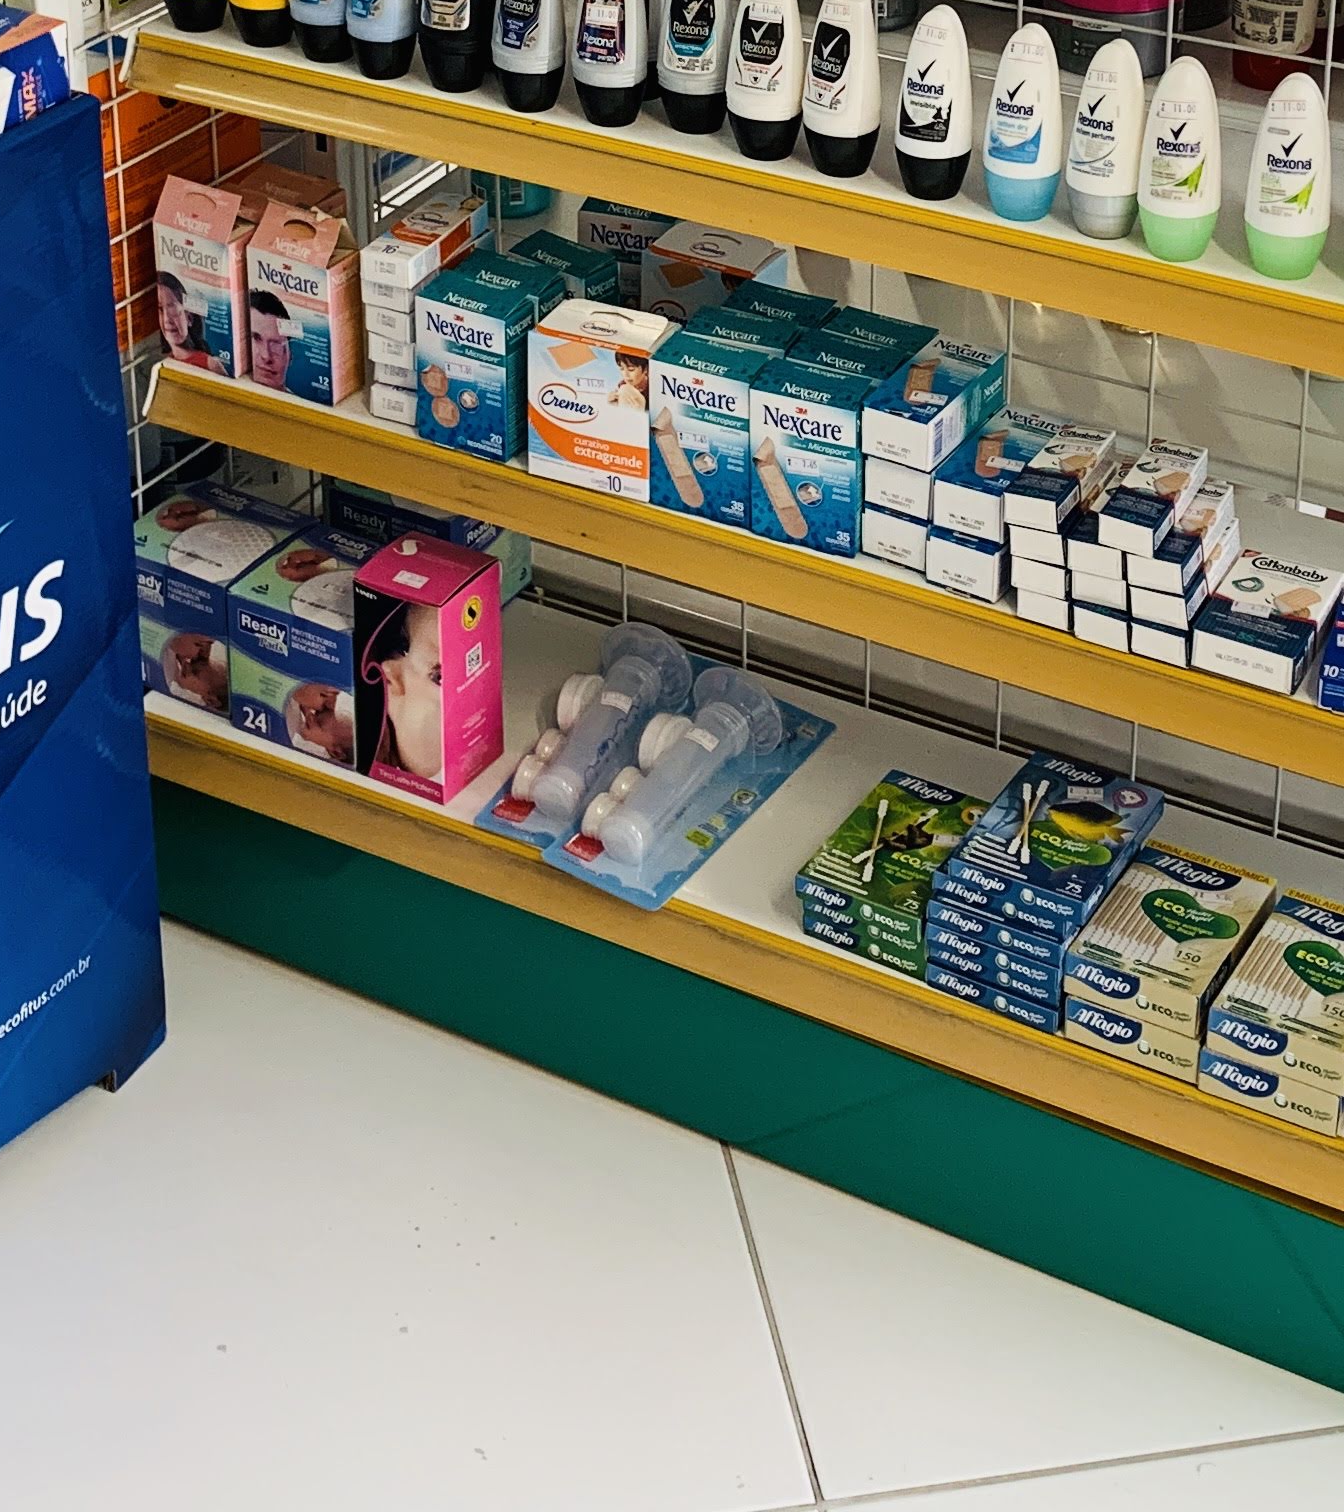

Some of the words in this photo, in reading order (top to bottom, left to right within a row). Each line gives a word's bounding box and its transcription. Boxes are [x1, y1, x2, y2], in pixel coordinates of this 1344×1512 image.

[741, 40, 777, 55] Rexona
[160, 238, 220, 272] Nexcare
[257, 260, 320, 297] Nexcare
[426, 308, 494, 347] Nexcare
[933, 338, 993, 362] Nexcare
[317, 375, 329, 387] 12
[661, 374, 736, 413] Nexcare
[539, 389, 596, 417] Cremer
[764, 405, 842, 442] Nexcare
[490, 433, 503, 445] 20
[574, 436, 610, 451] curativo
[573, 445, 644, 470] extragrande
[606, 475, 622, 492] 10
[730, 500, 745, 512] 35
[836, 530, 850, 543] 35
[241, 614, 285, 640] Ready
[243, 707, 267, 733] 24
[1045, 759, 1103, 786] Affagio
[897, 776, 954, 803] Affagio
[1065, 882, 1082, 894] 75
[1073, 961, 1131, 994] Affagio
[1073, 1007, 1133, 1044] Affagio
[1210, 1019, 1279, 1052] Affagio
[1205, 1059, 1270, 1094] Affagio
